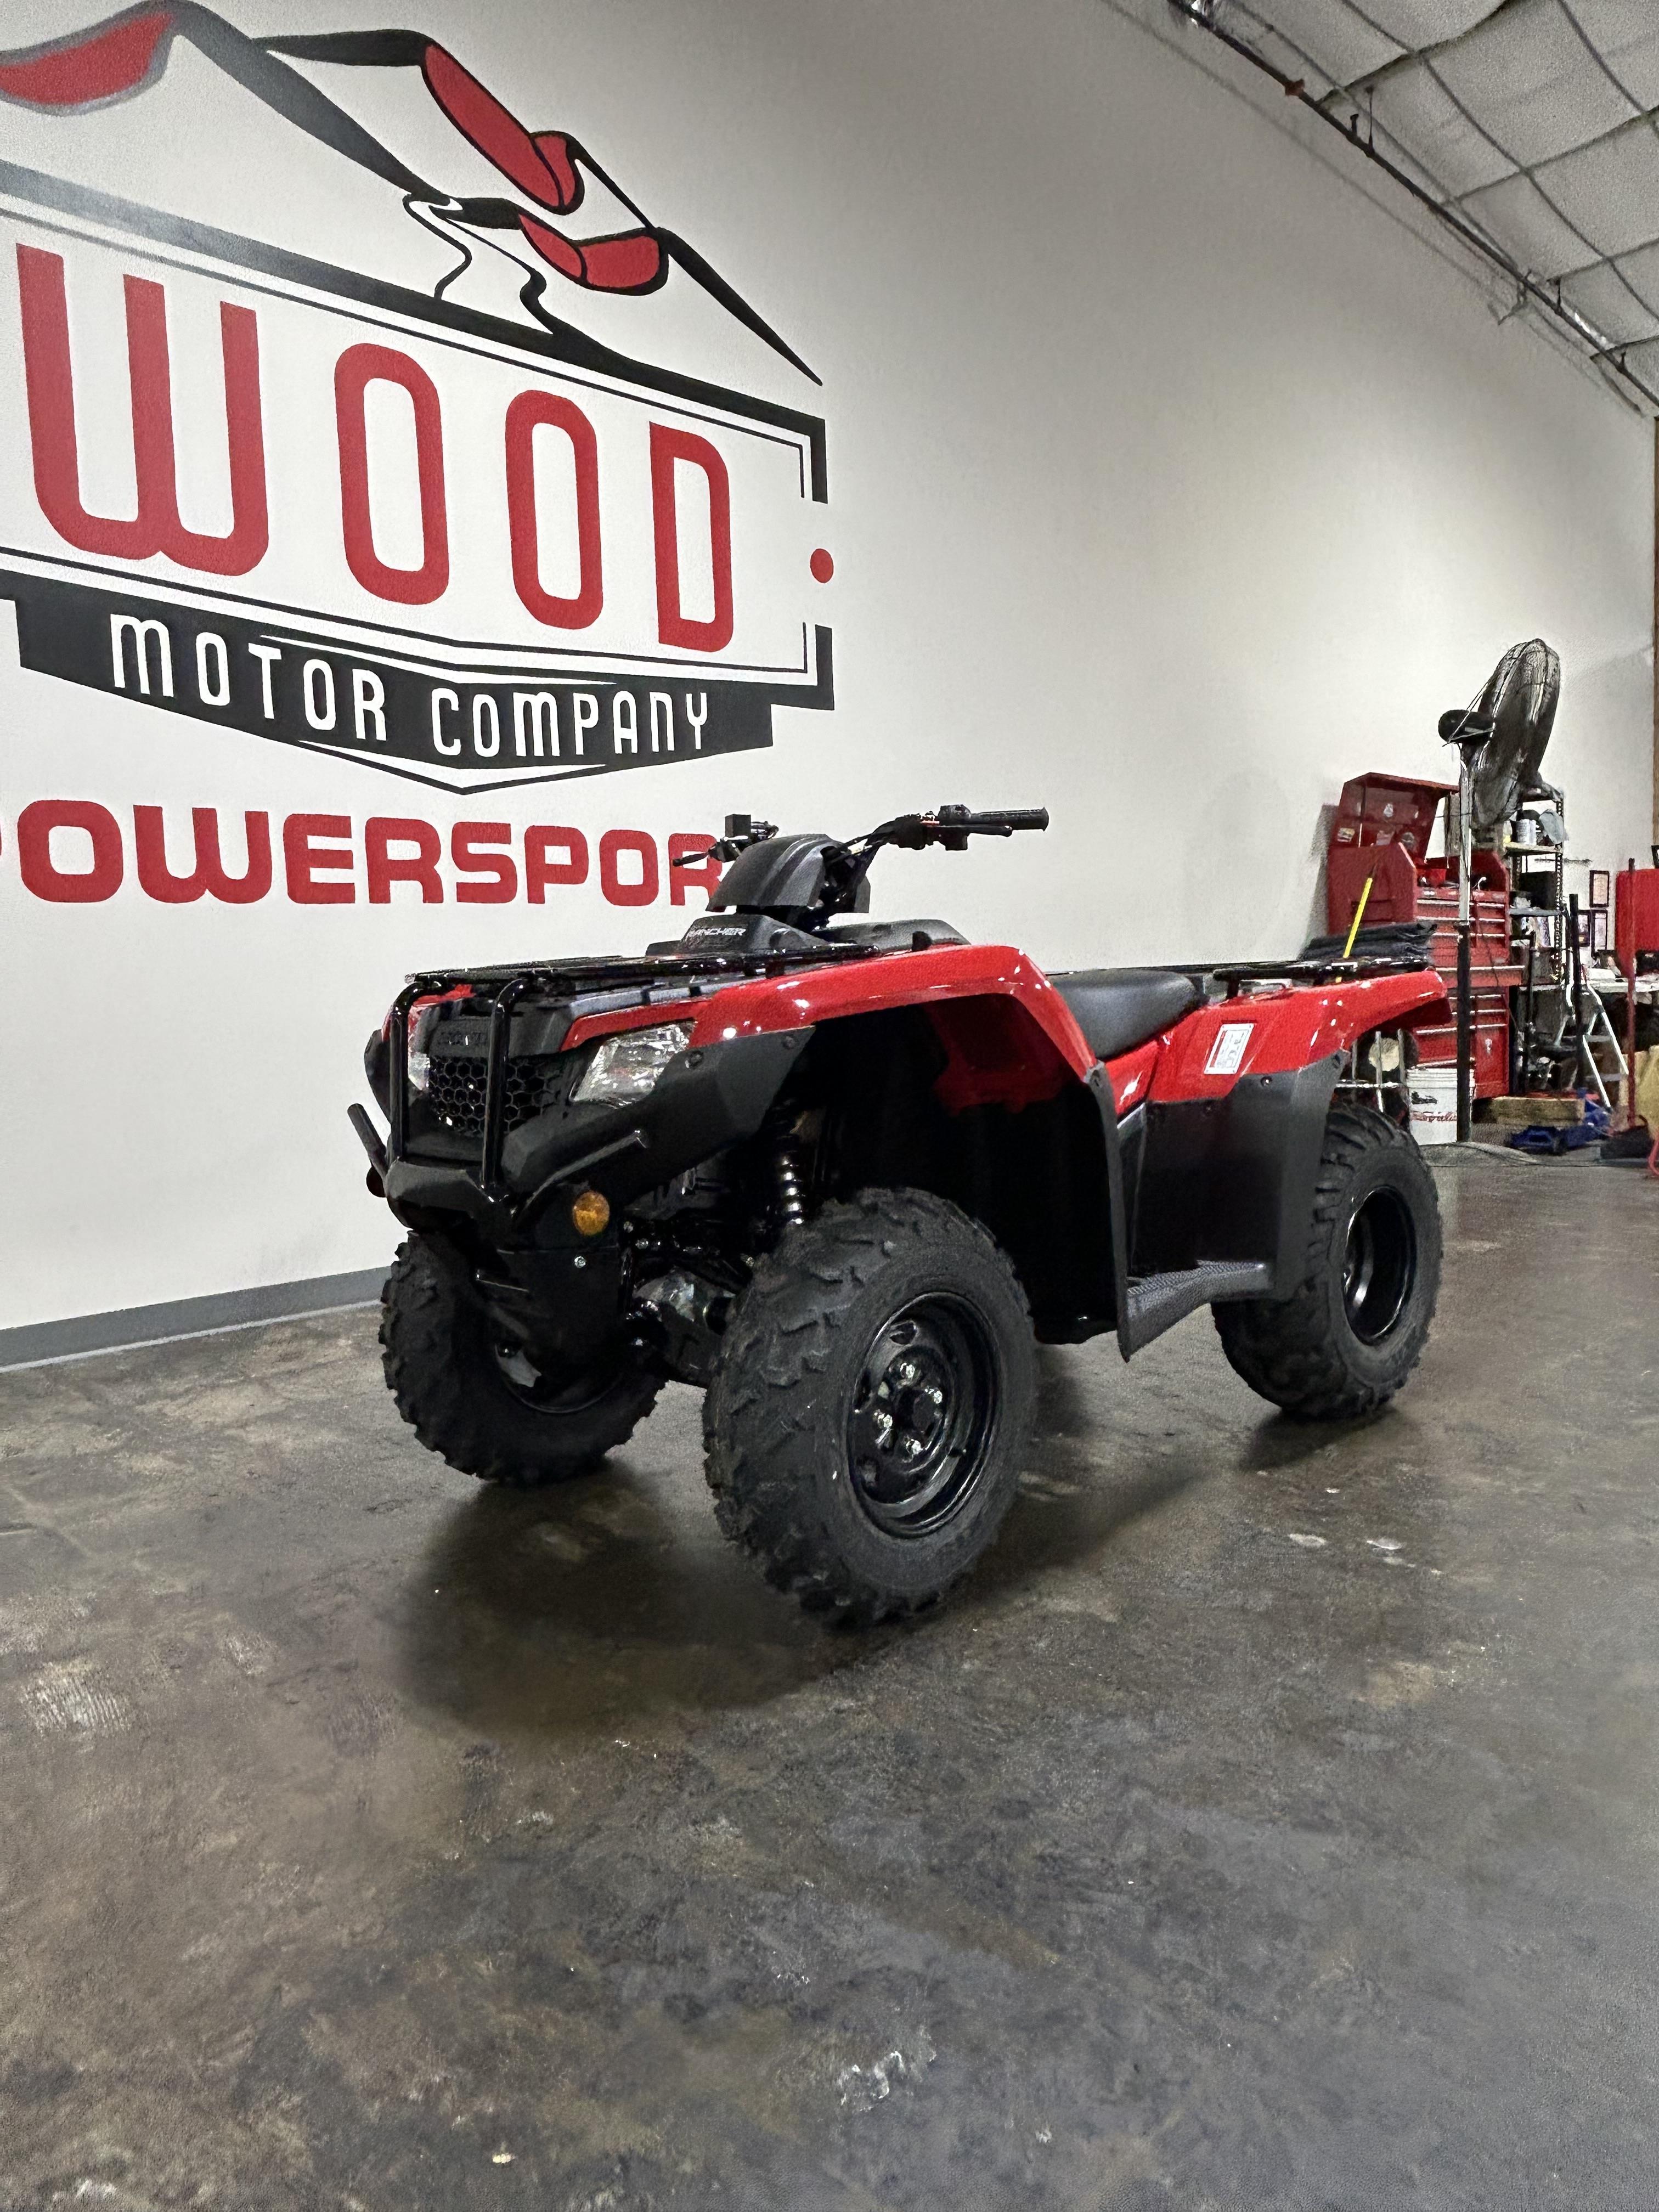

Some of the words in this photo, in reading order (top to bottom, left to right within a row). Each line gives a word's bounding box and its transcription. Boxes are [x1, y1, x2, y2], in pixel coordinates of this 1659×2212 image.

[16, 243, 733, 652] WOOD
[110, 613, 386, 741] MOTOR
[431, 688, 708, 757] COMPANY
[0, 799, 723, 907] OWERSPOR
